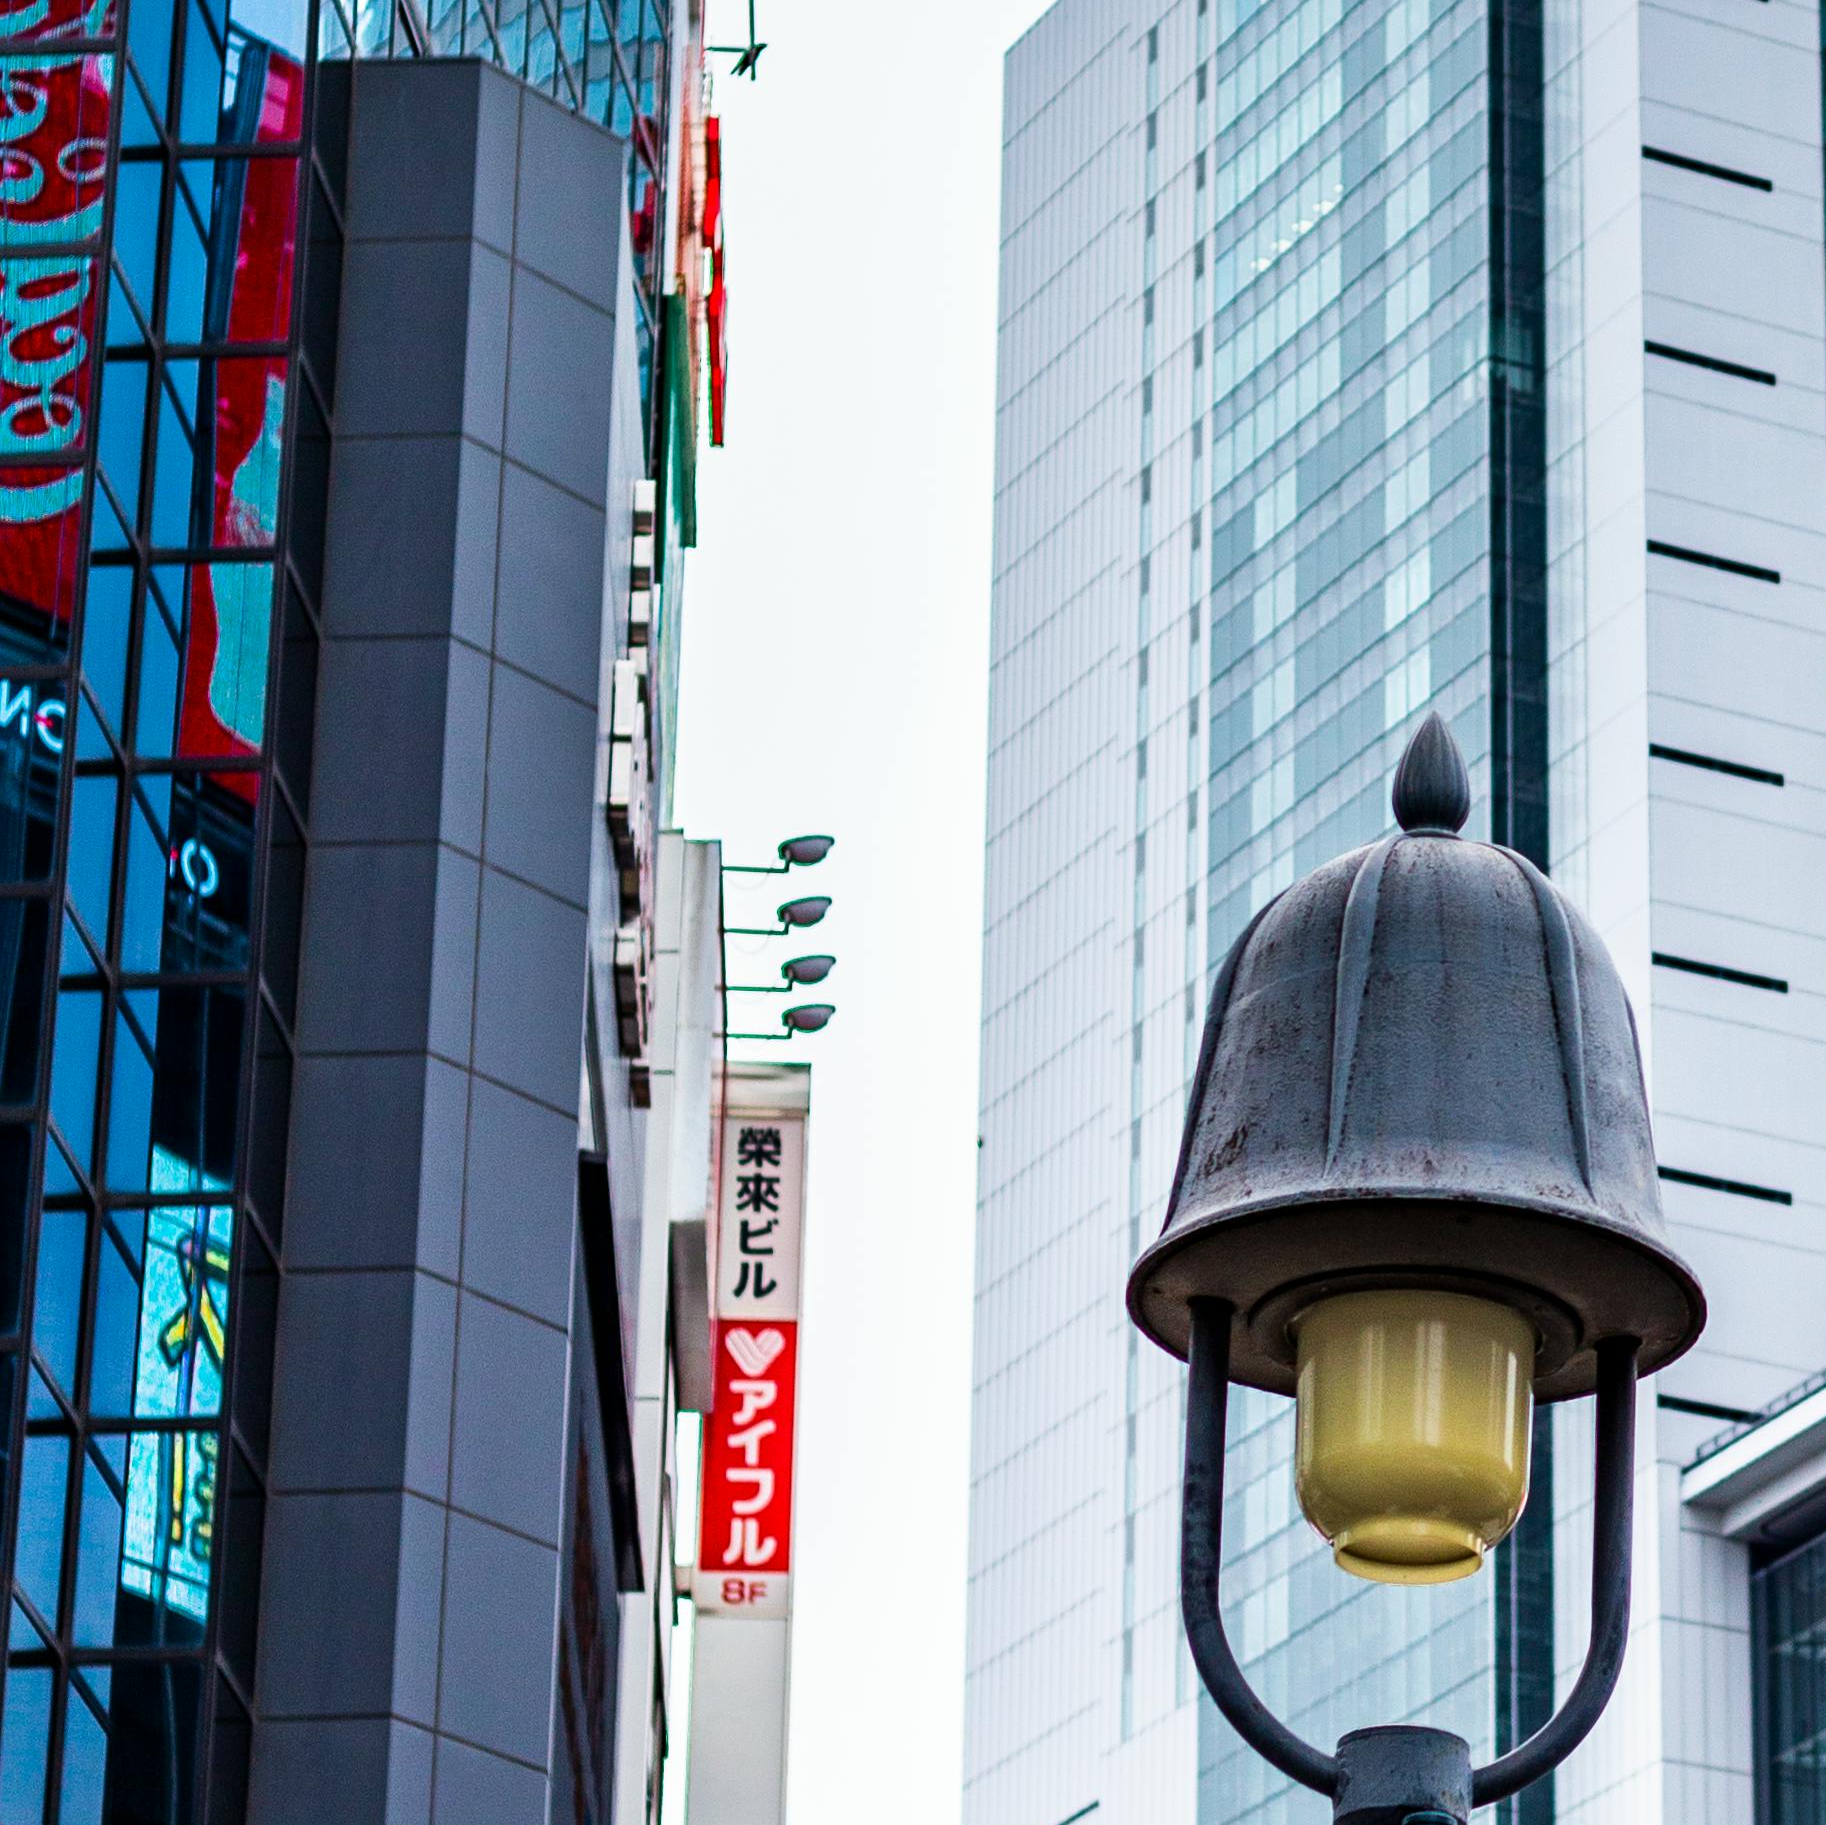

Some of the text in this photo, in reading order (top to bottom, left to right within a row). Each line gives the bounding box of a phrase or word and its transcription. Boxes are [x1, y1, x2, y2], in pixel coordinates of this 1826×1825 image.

[732, 1125, 782, 1300] 榮來ビル
[722, 1380, 777, 1568] アイフル
[720, 1577, 768, 1607] 8F
